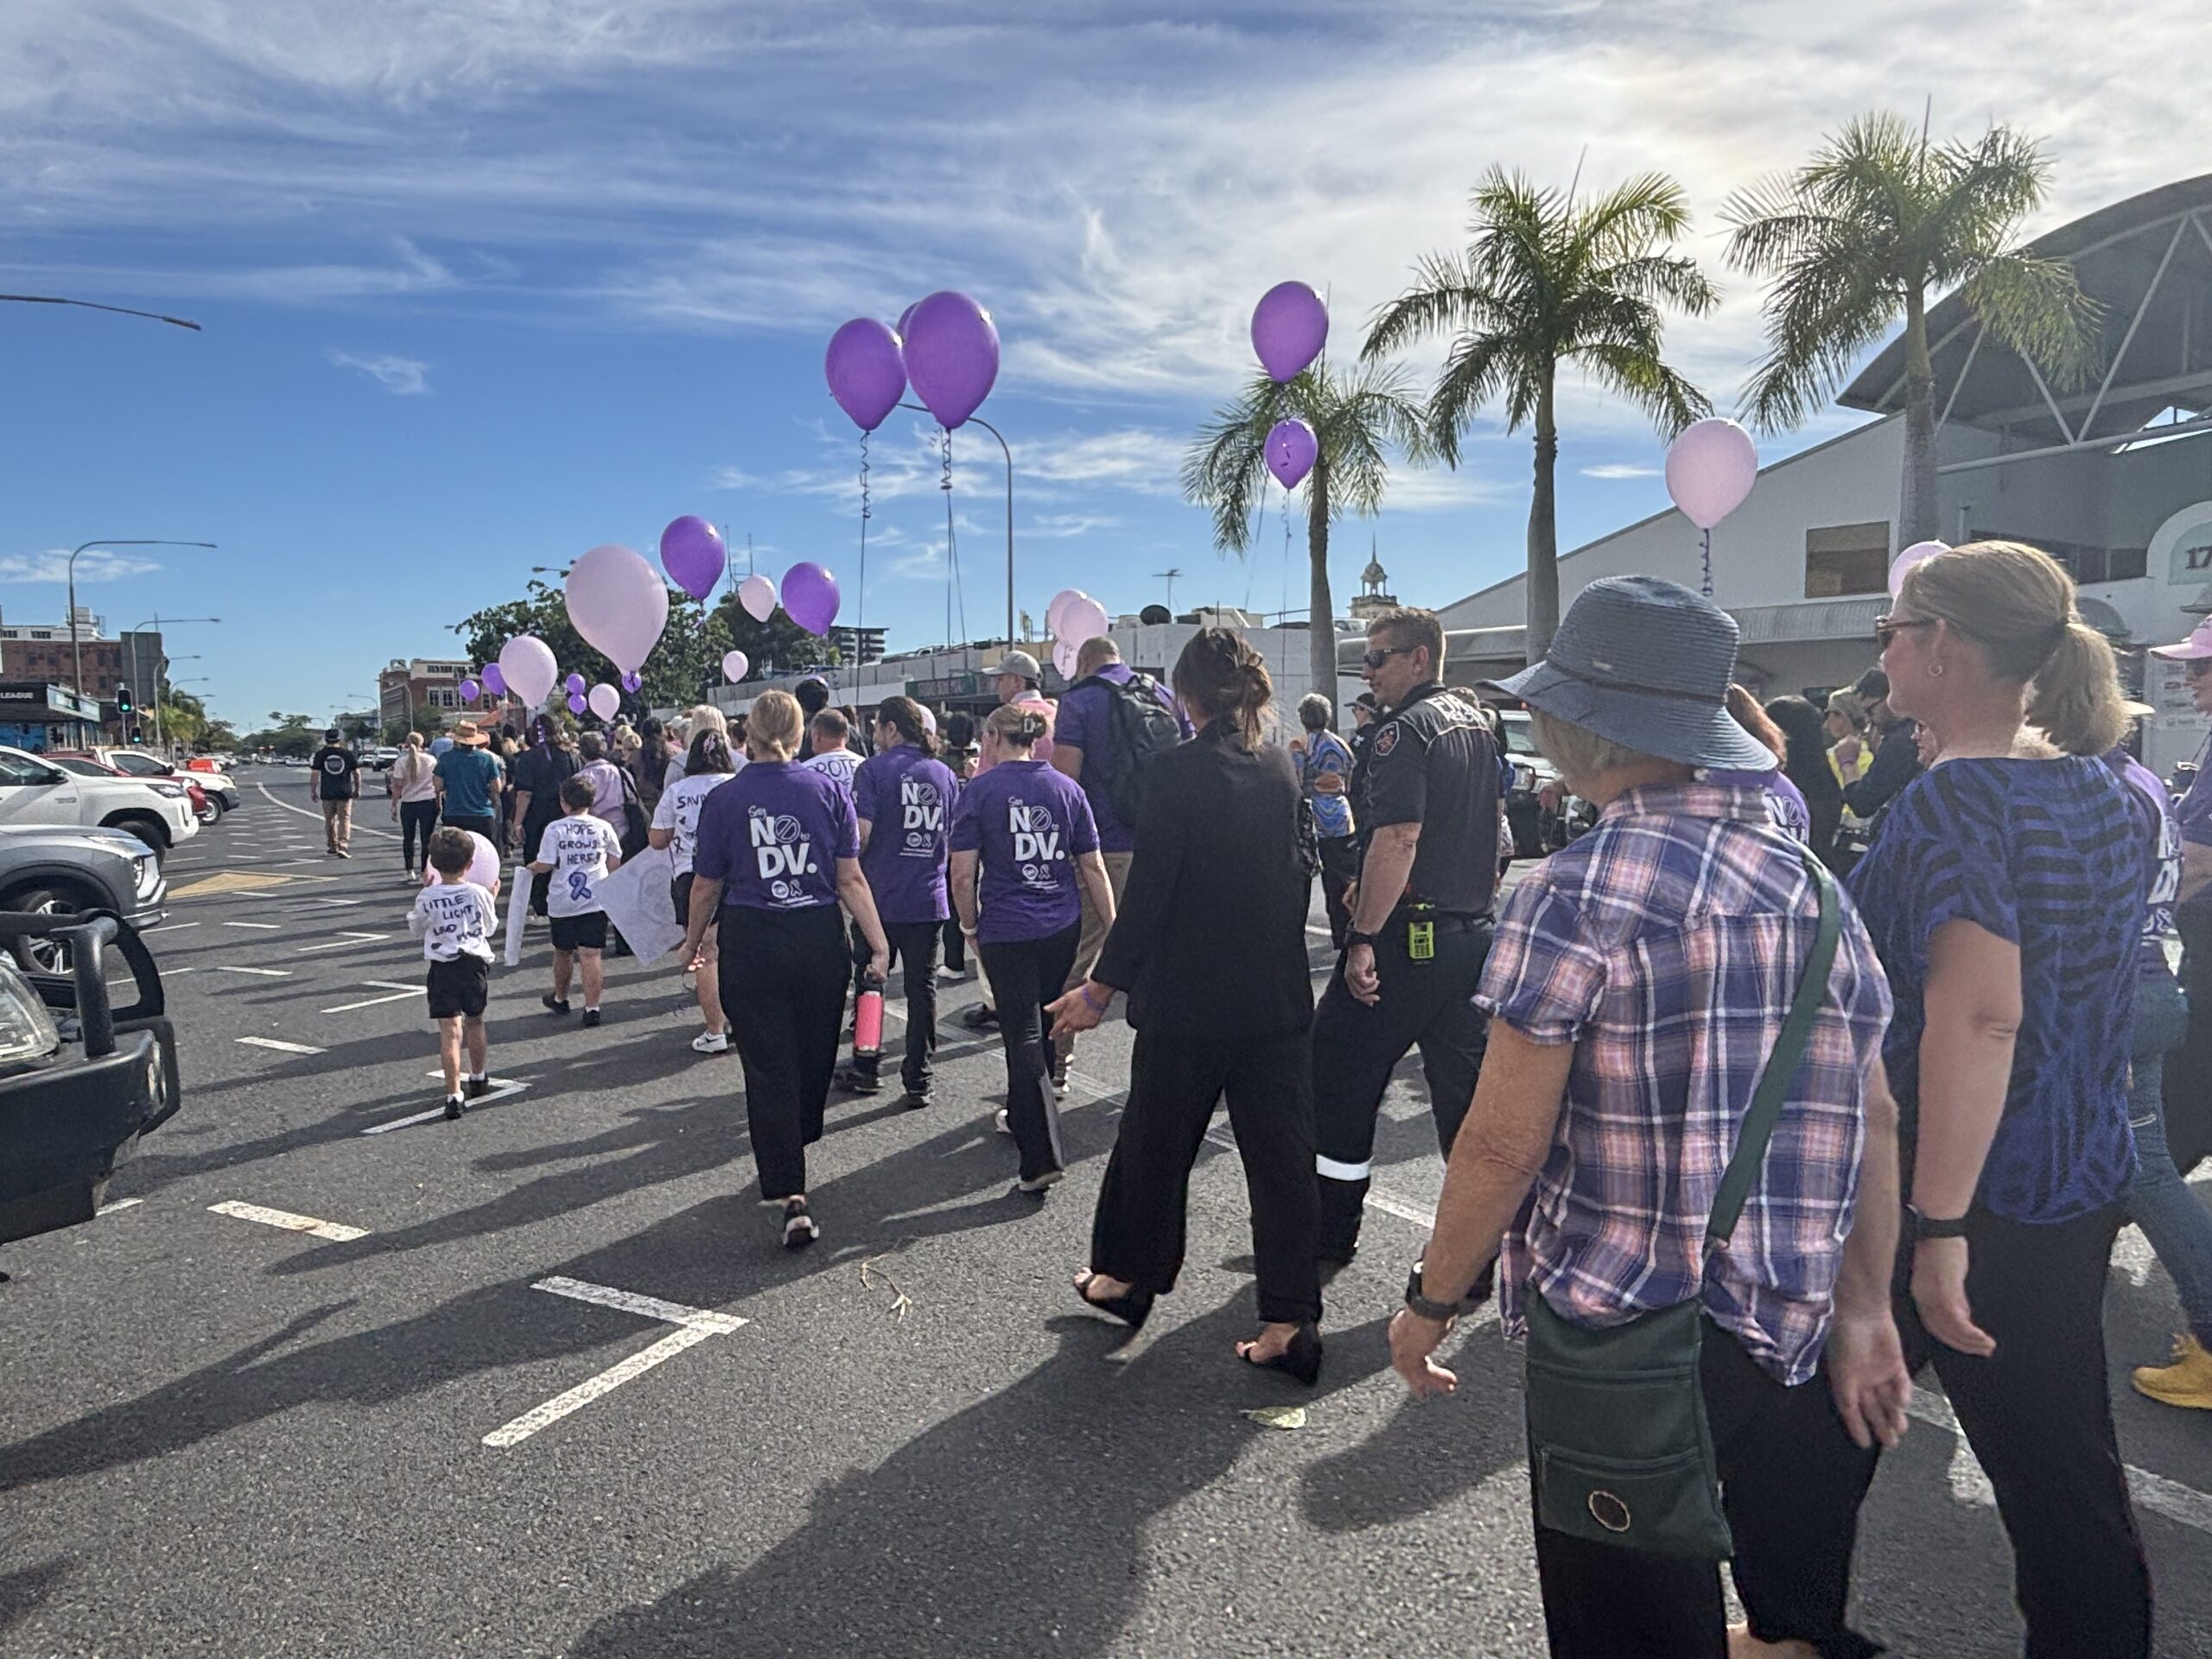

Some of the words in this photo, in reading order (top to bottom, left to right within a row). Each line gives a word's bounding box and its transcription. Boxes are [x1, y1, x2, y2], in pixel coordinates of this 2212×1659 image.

[904, 805, 944, 831] DV.
[565, 823, 596, 836] HOPE
[559, 840, 598, 850] GROWS
[1014, 832, 1065, 861] DV.
[758, 842, 817, 879] DV.
[423, 894, 467, 913] LITTLE
[442, 905, 474, 920] LIGHT
